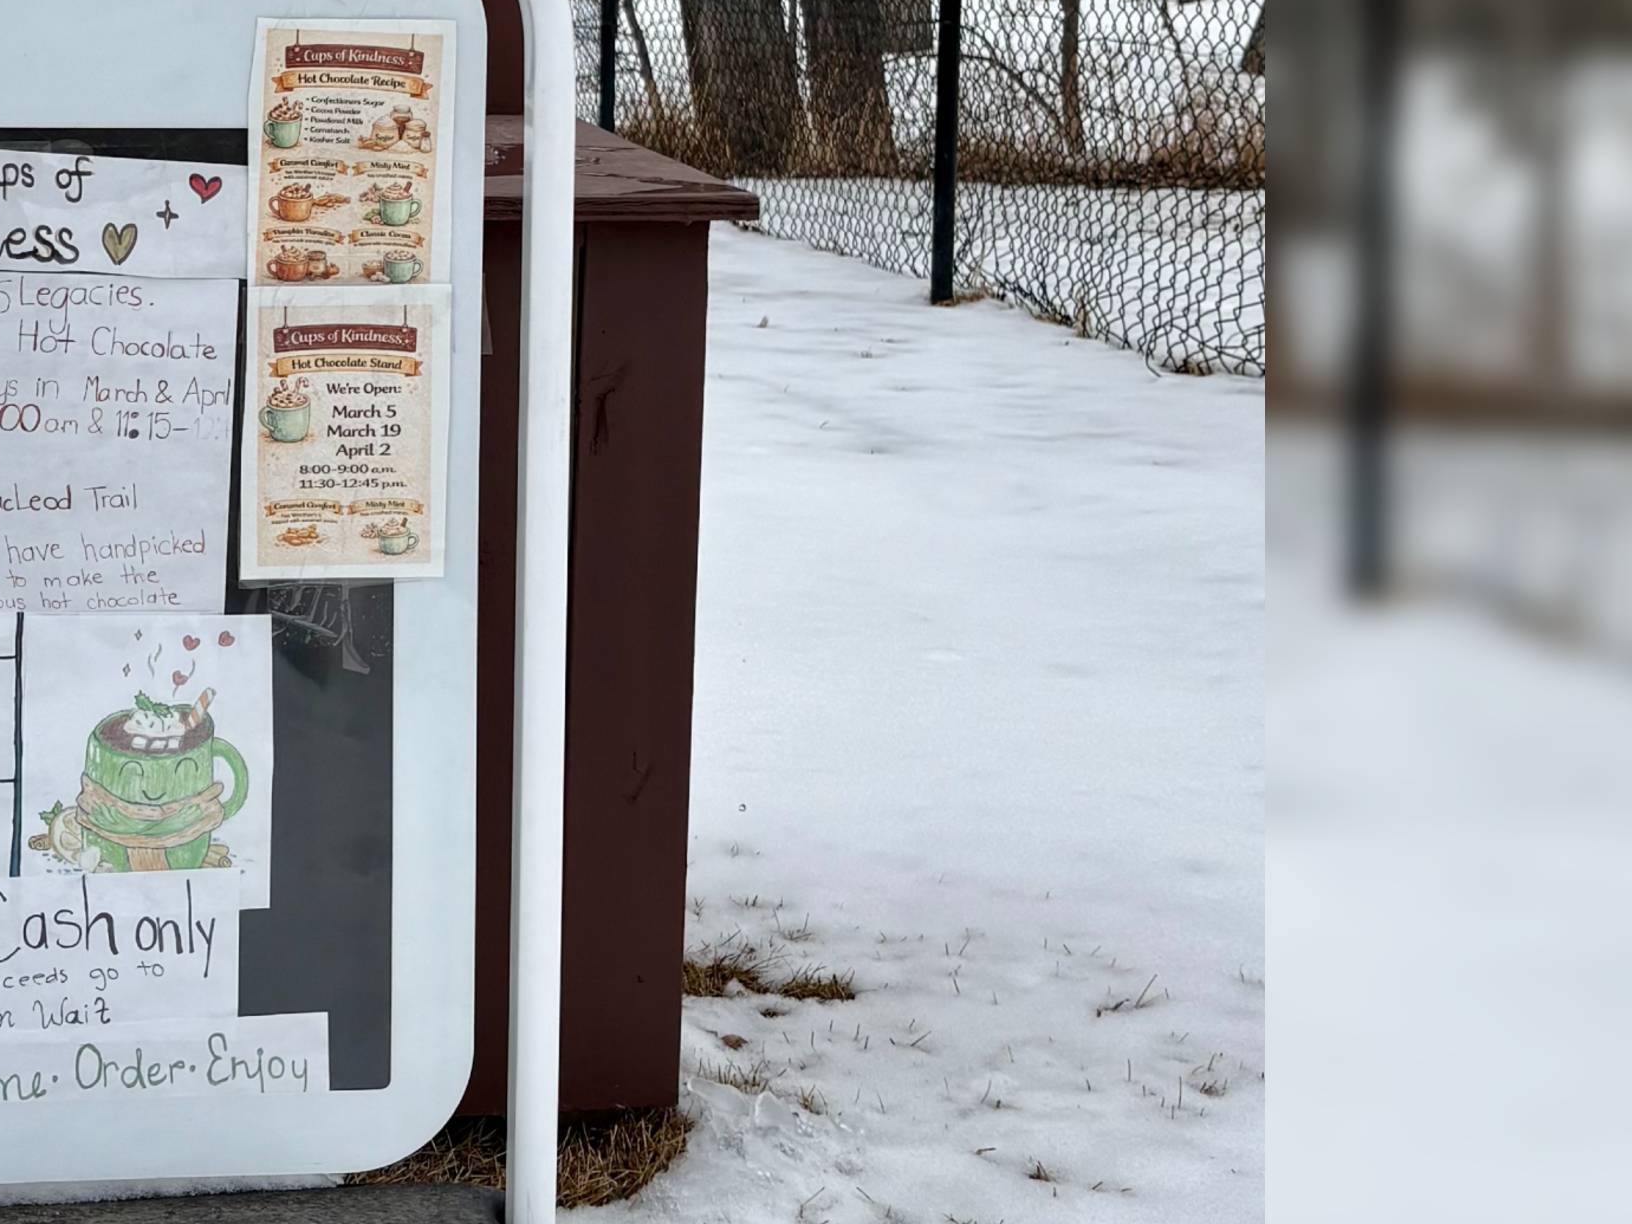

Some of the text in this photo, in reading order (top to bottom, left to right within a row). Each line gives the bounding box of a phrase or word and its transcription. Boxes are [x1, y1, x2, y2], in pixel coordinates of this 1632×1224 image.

[303, 49, 405, 66] Cups of Kindness
[298, 73, 406, 89] Hot Chocolate Recipe
[363, 98, 385, 108] Sugar
[55, 155, 93, 203] of
[18, 318, 77, 353] Hot
[91, 326, 218, 360] Chocolate
[291, 329, 402, 345] Cups of Kindness
[291, 357, 403, 370] Hot Chocolate Stand
[36, 377, 60, 399] in
[83, 375, 148, 403] March
[154, 379, 174, 404] &
[326, 382, 402, 396] We're Open:
[87, 407, 104, 434] &
[332, 404, 397, 418] March 5
[327, 423, 401, 438] March 19
[335, 443, 392, 459] April 2
[299, 464, 369, 474] 8:00-9:00
[299, 479, 379, 489] 11:30-12:45
[83, 482, 138, 511] Trail
[4, 535, 65, 564] have
[80, 528, 206, 564] handpicked
[5, 570, 27, 588] to
[44, 570, 104, 588] make
[120, 564, 160, 585] the
[40, 591, 72, 611] hot
[87, 586, 182, 611] chocolate
[135, 879, 216, 977] only
[89, 967, 119, 990] go
[136, 961, 165, 977] to
[32, 996, 112, 1030] Wait
[206, 1032, 309, 1093] Enjoy
